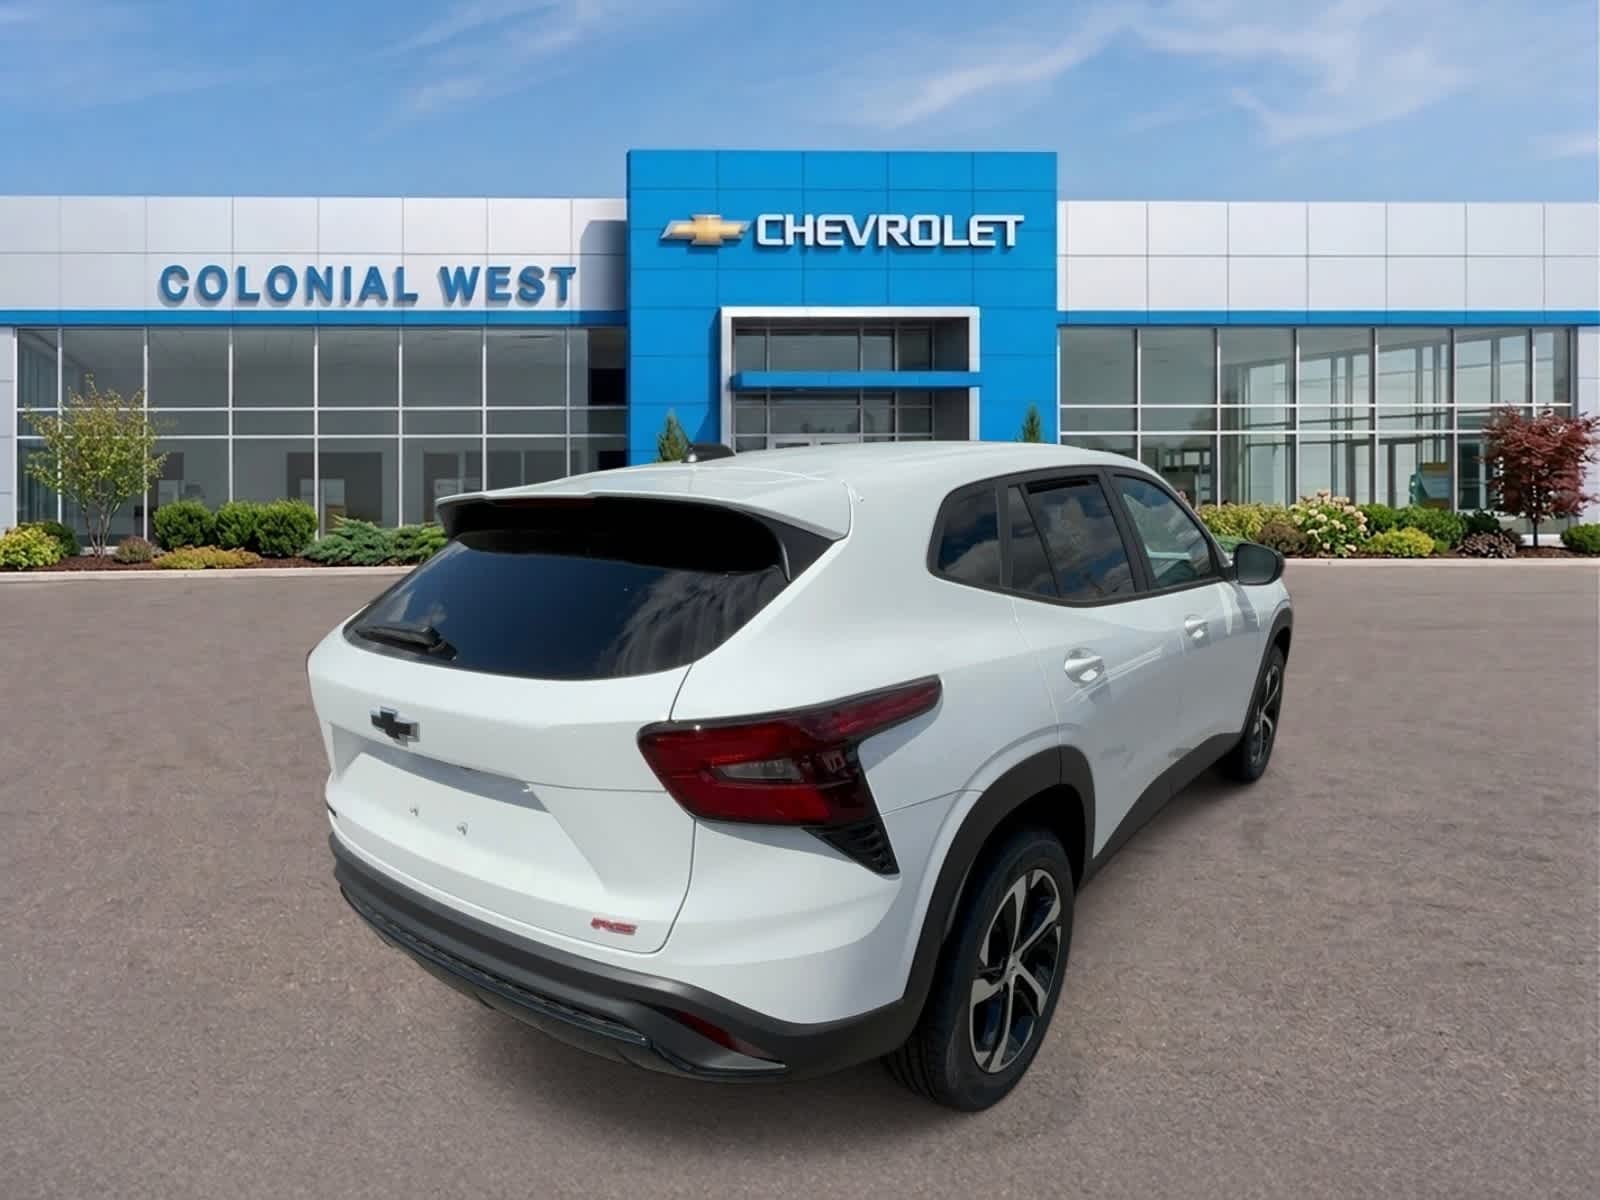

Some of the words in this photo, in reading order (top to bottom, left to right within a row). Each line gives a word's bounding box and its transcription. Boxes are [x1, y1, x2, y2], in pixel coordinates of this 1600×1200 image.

[756, 213, 1025, 248] CHEVROLET
[161, 264, 418, 304] COLONIAL
[439, 265, 577, 304] WEST
